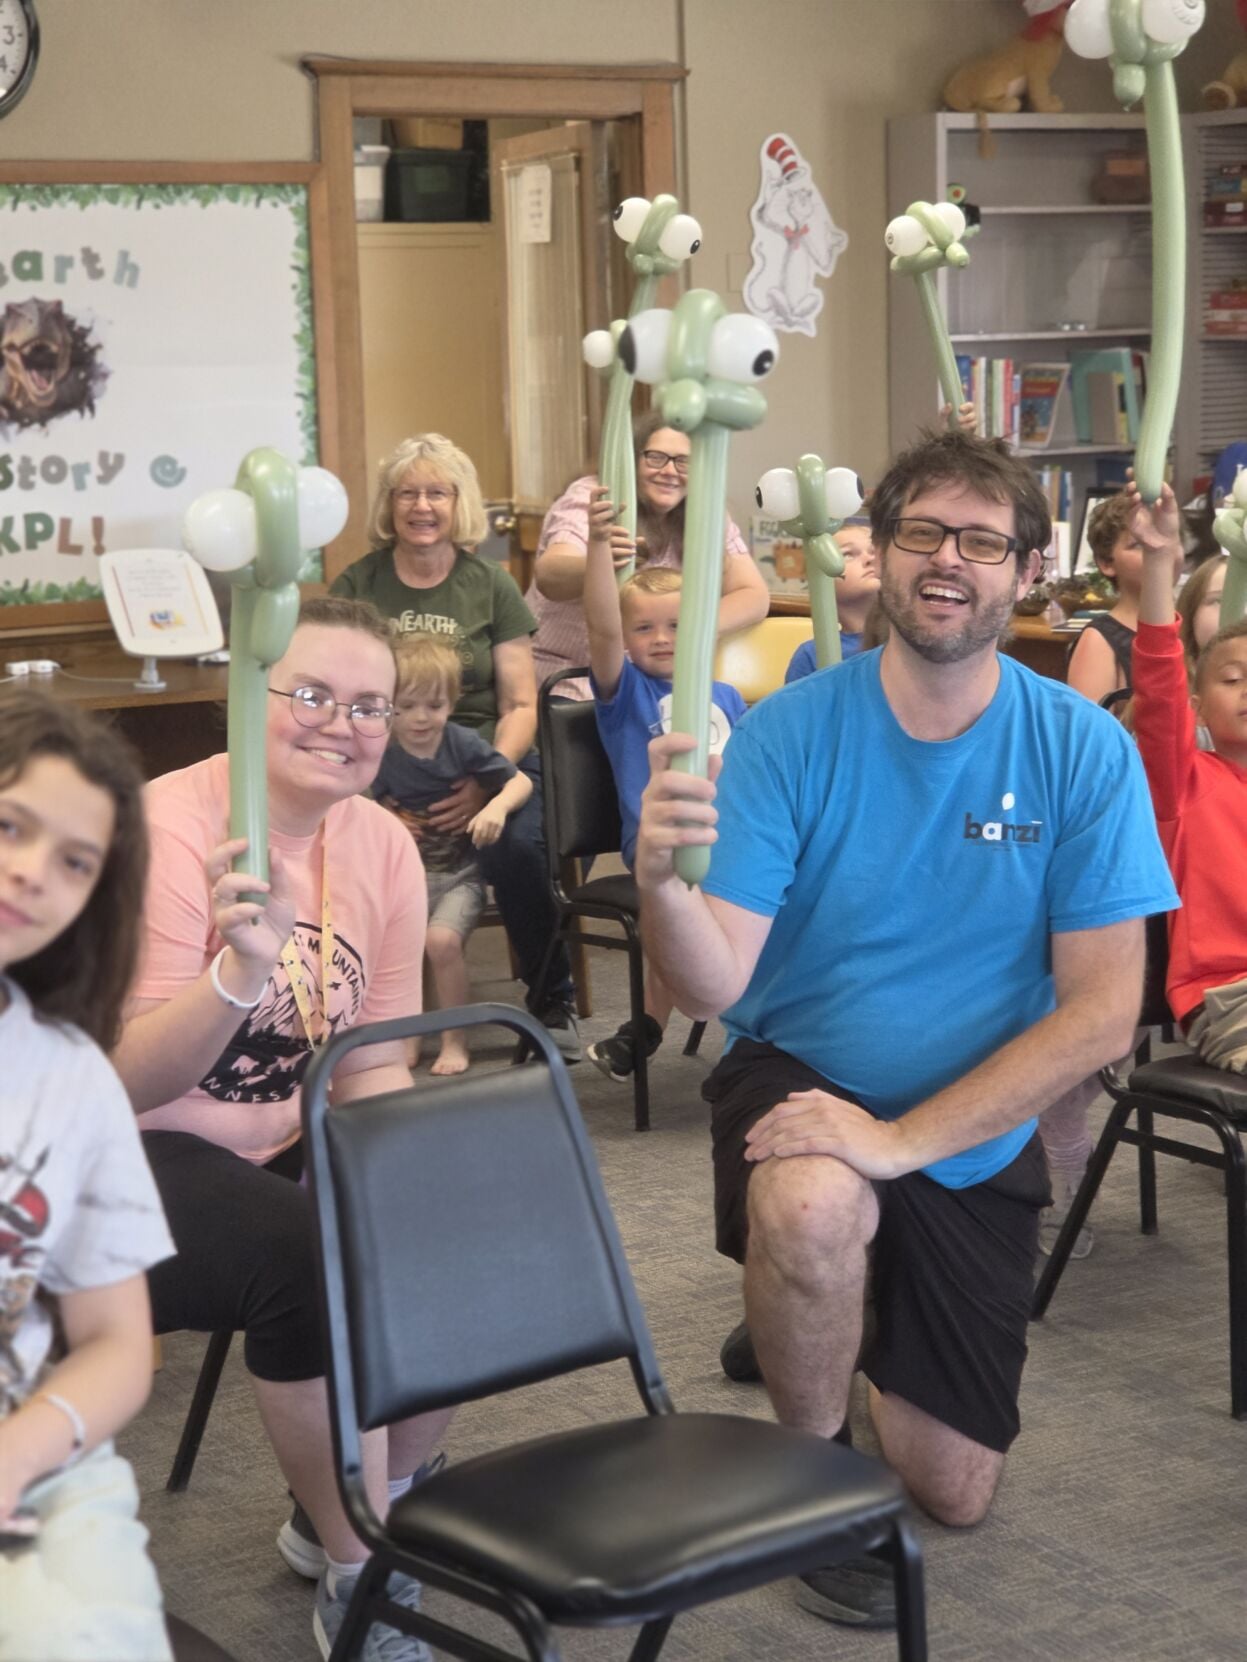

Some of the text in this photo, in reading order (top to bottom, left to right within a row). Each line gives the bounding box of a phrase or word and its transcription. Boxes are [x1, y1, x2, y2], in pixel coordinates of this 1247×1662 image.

[3, 25, 15, 45] 3
[0, 246, 141, 289] arth
[0, 450, 125, 491] Story
